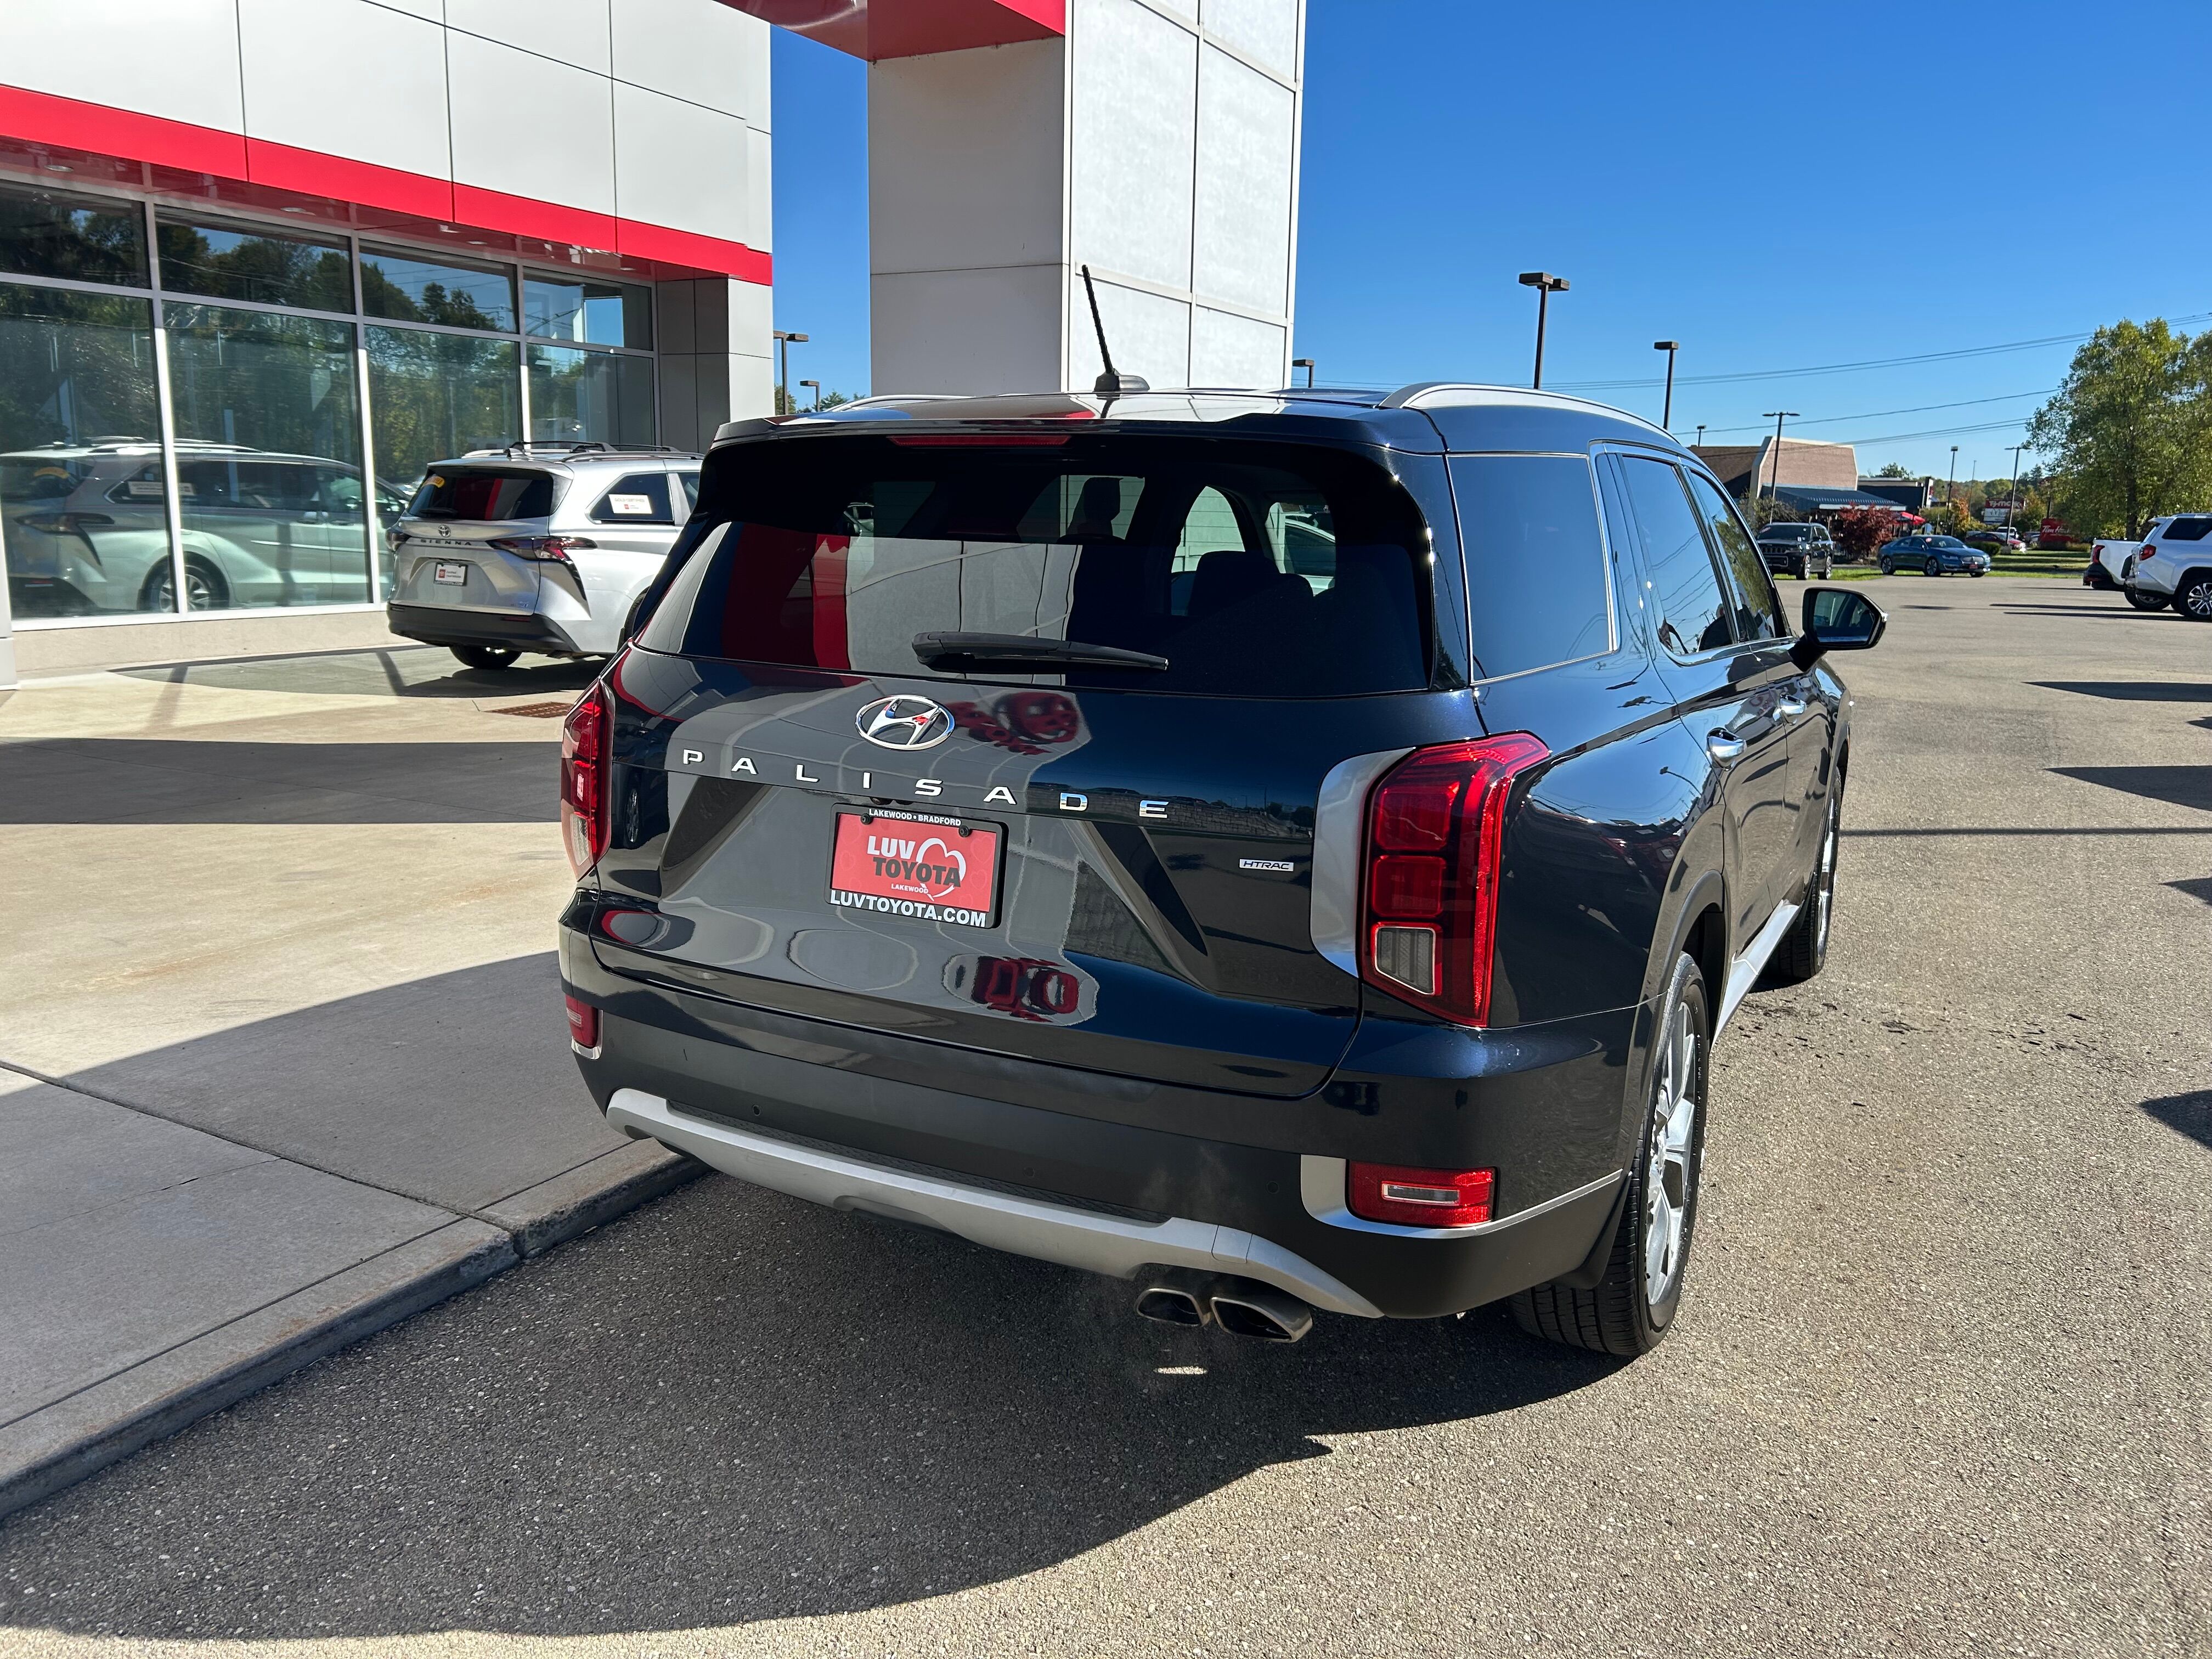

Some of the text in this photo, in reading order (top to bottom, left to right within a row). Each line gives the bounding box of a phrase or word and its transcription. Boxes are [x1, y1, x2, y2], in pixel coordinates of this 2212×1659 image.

[682, 749, 1169, 819] PALISADE
[868, 809, 962, 826] LAKEWOOD BRADFORD
[867, 835, 916, 859] LUV
[873, 856, 961, 887] TOYOTA
[1243, 861, 1290, 870] HTRAC
[891, 883, 929, 894] LAKEWOOD
[830, 890, 986, 927] LUVTOYOTA.COM
